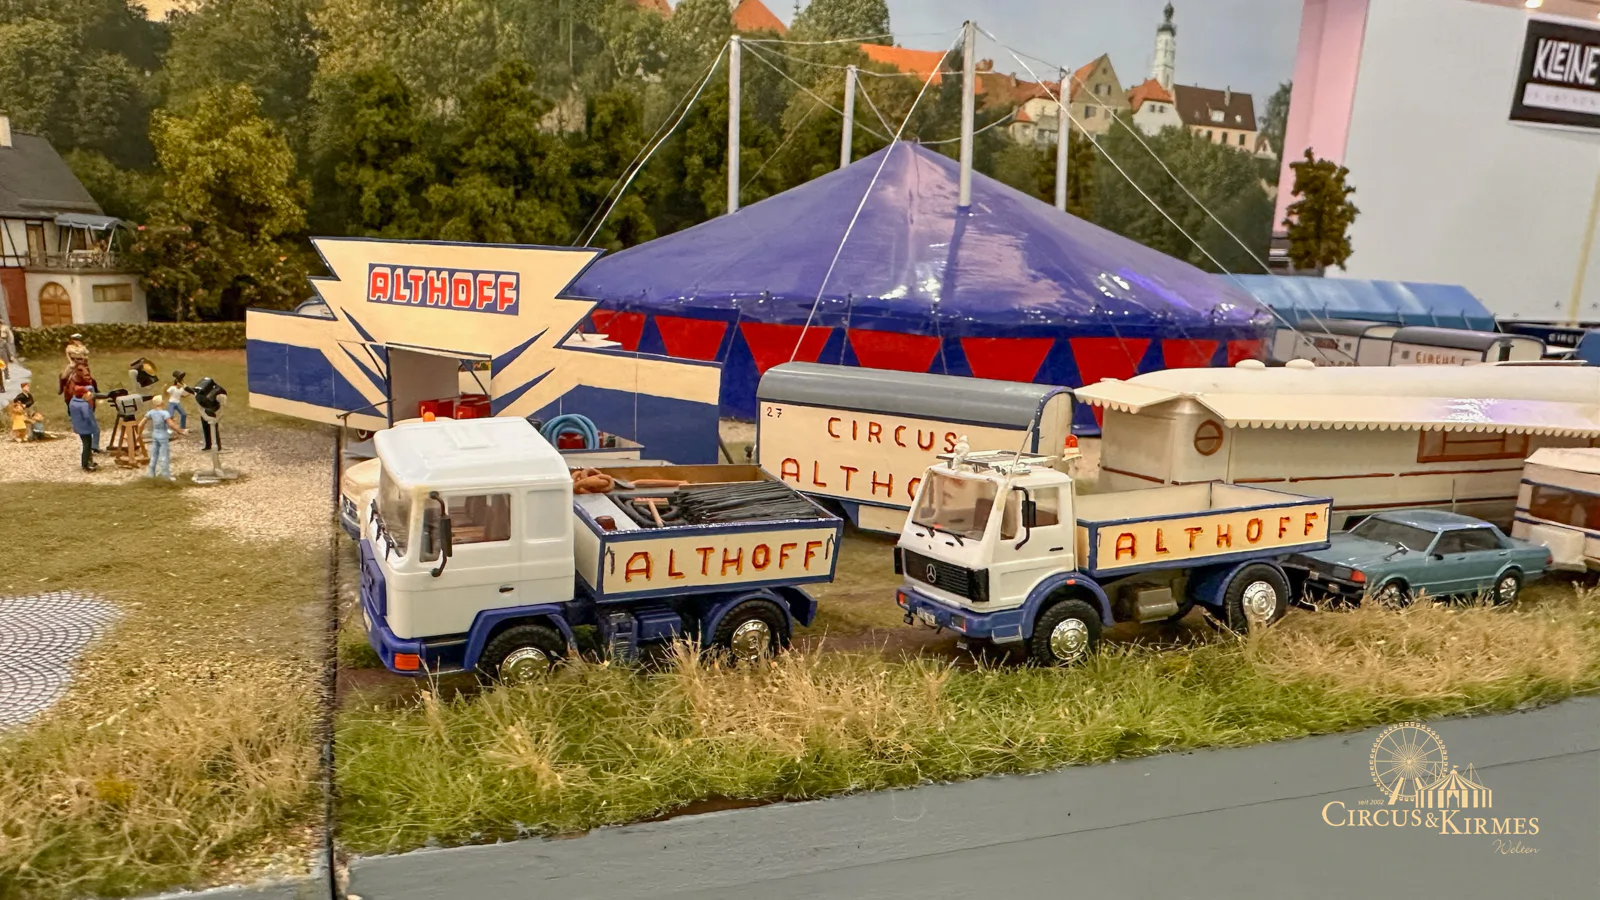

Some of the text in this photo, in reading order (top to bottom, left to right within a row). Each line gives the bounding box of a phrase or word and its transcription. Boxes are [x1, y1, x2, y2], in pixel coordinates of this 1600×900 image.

[1533, 38, 1600, 85] KLEINE
[369, 266, 517, 312] ALTHOFF
[766, 407, 783, 418] 27
[828, 417, 957, 454] CIRCUS
[1115, 512, 1319, 561] ALTHOFF
[625, 540, 823, 583] ALTHOFF
